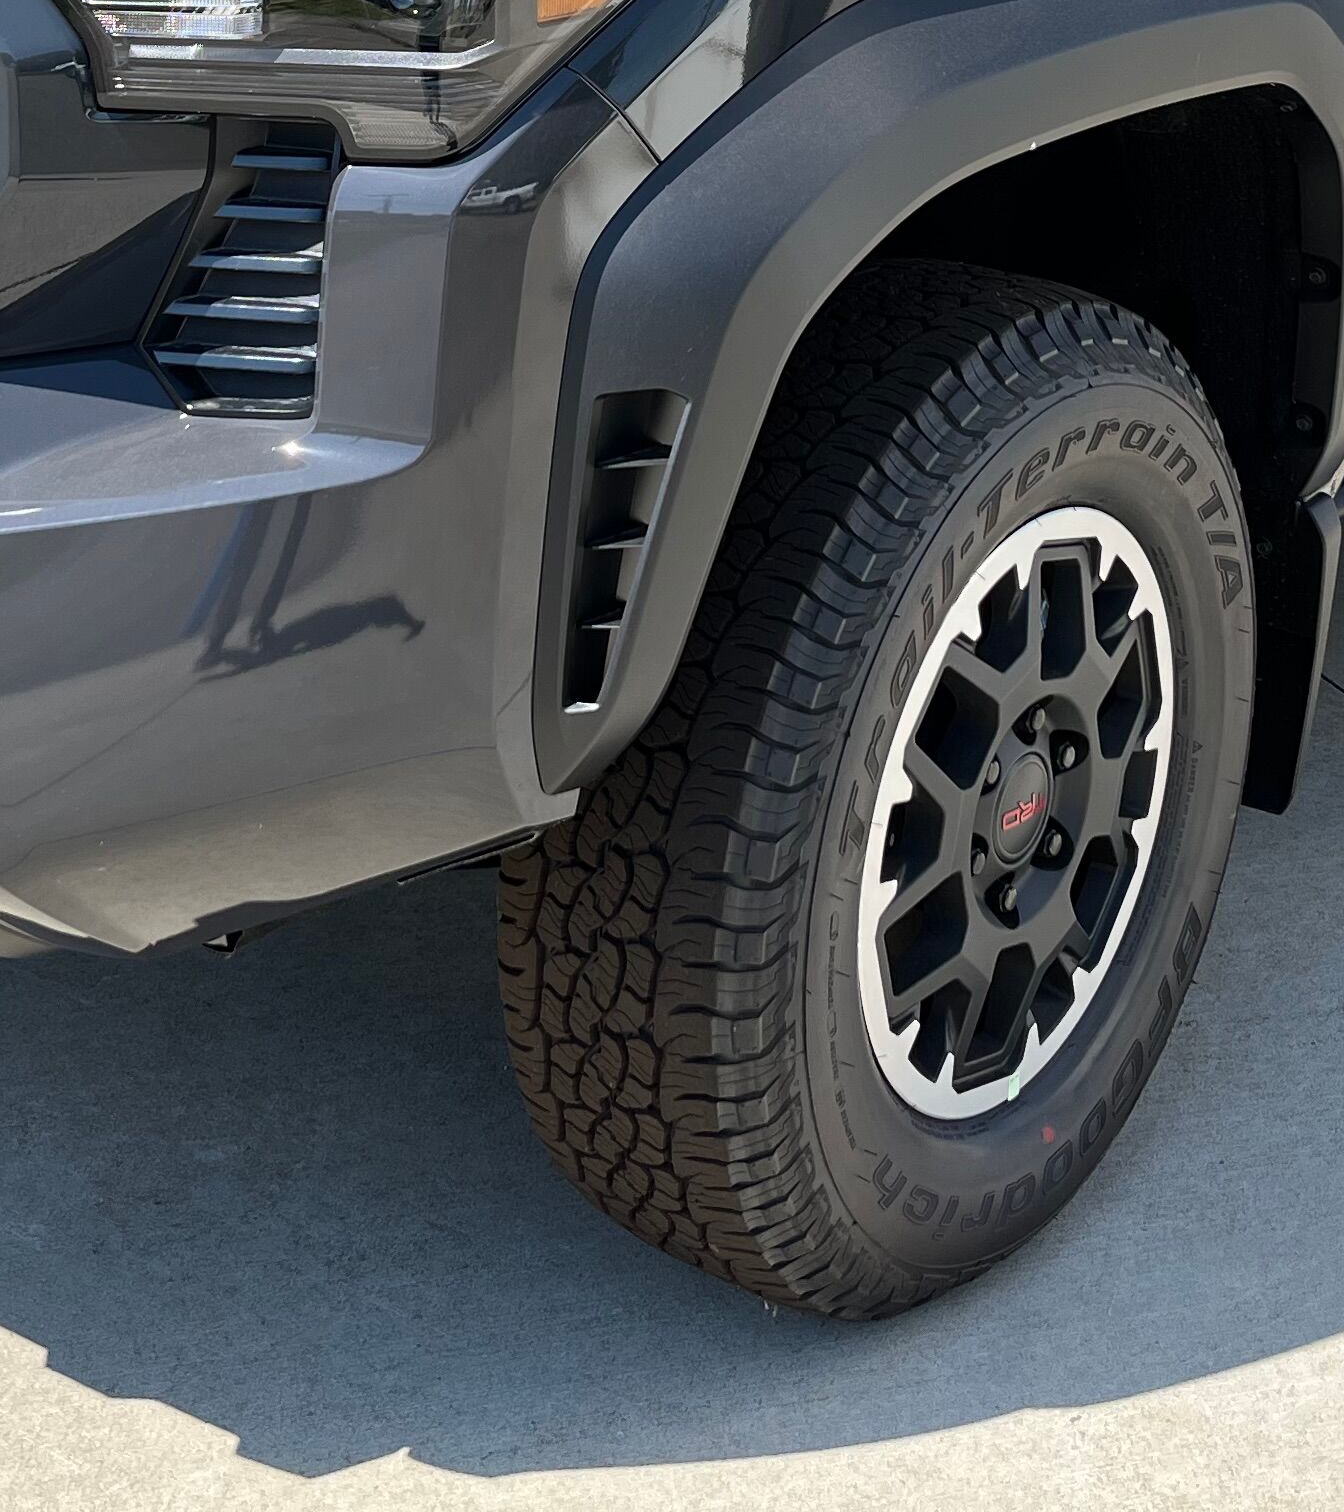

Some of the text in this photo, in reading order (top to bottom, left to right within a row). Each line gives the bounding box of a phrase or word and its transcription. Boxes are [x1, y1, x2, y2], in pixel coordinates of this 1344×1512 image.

[839, 418, 1199, 856] Trail-Terrain
[1001, 792, 1047, 831] TRD
[871, 901, 1203, 1241] BFGoodrich
